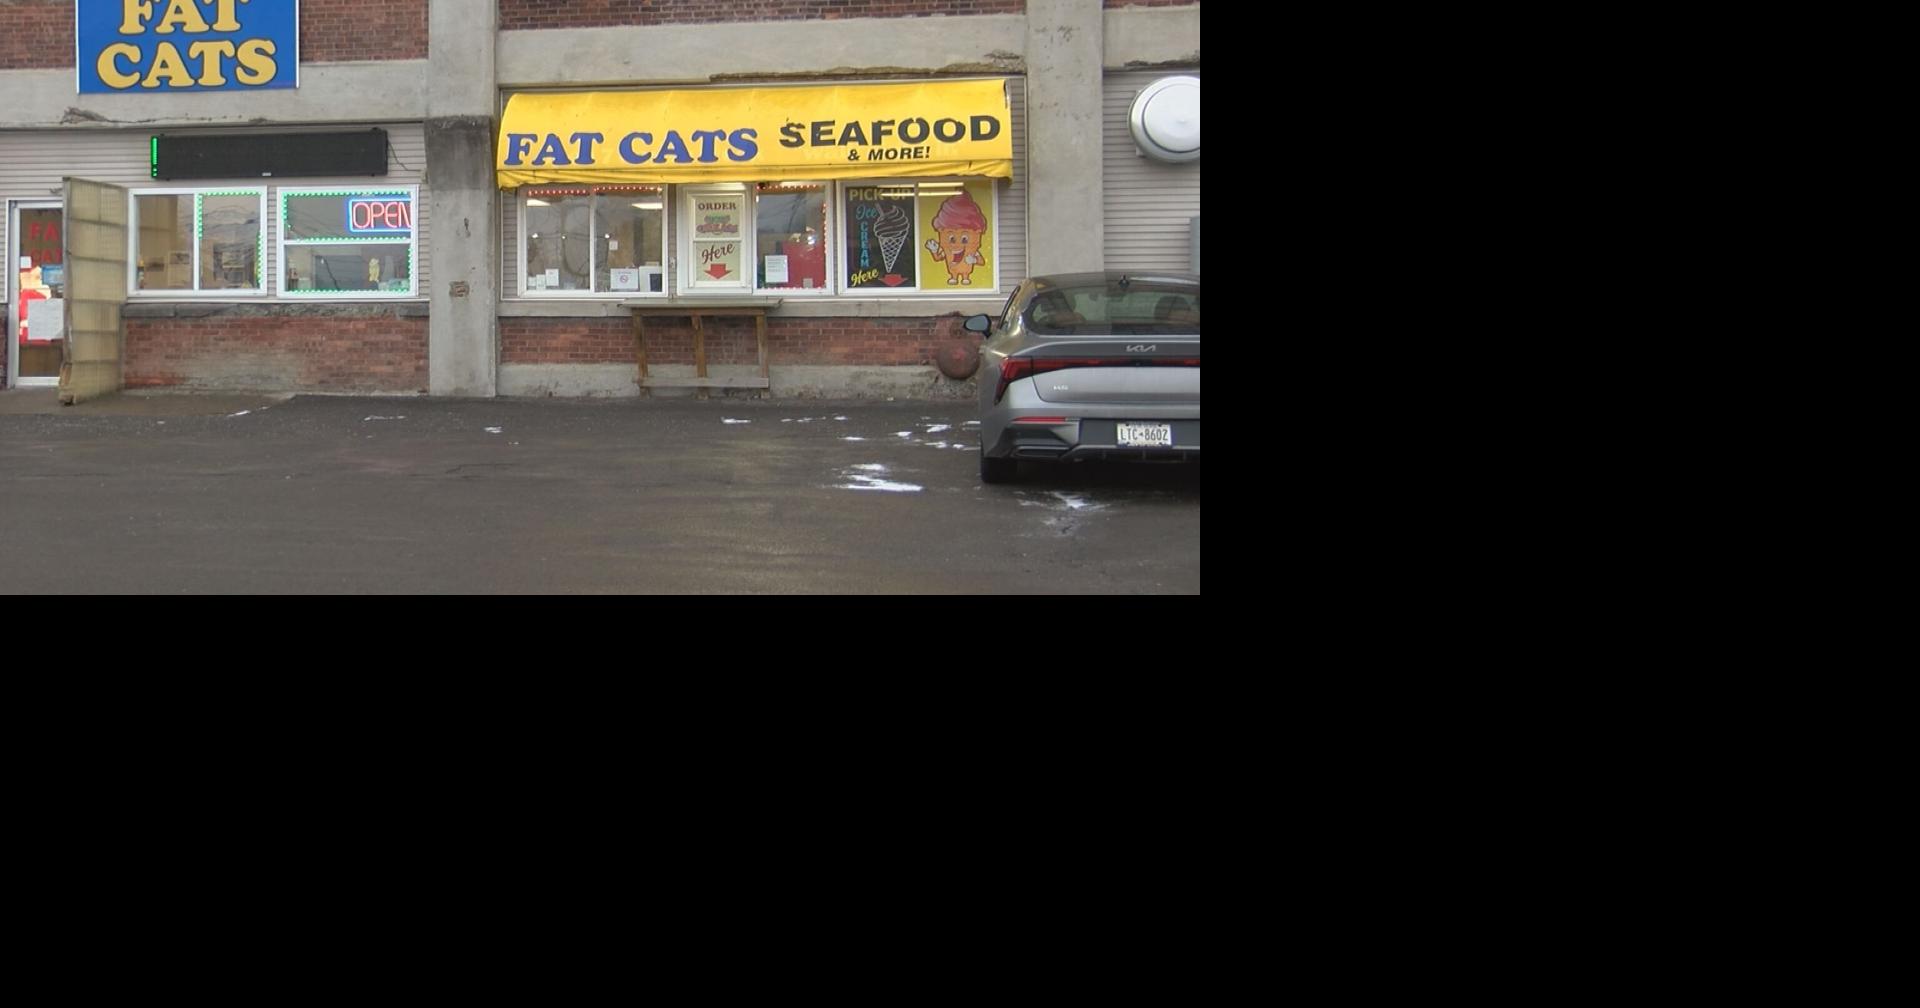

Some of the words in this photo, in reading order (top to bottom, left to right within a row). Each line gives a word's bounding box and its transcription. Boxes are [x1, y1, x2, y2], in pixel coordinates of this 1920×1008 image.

[118, 0, 249, 34] FAT
[96, 38, 277, 89] CATS
[503, 130, 604, 165] FAT
[618, 127, 760, 164] CATS
[779, 114, 1001, 149] SEAFOOD
[847, 148, 860, 161] &
[867, 145, 931, 161] MORE!
[352, 201, 411, 230] OPEN
[698, 201, 737, 211] ORDER
[855, 204, 877, 221] Ice
[702, 242, 736, 265] Here
[860, 221, 870, 268] CREAM
[850, 268, 879, 287] Here
